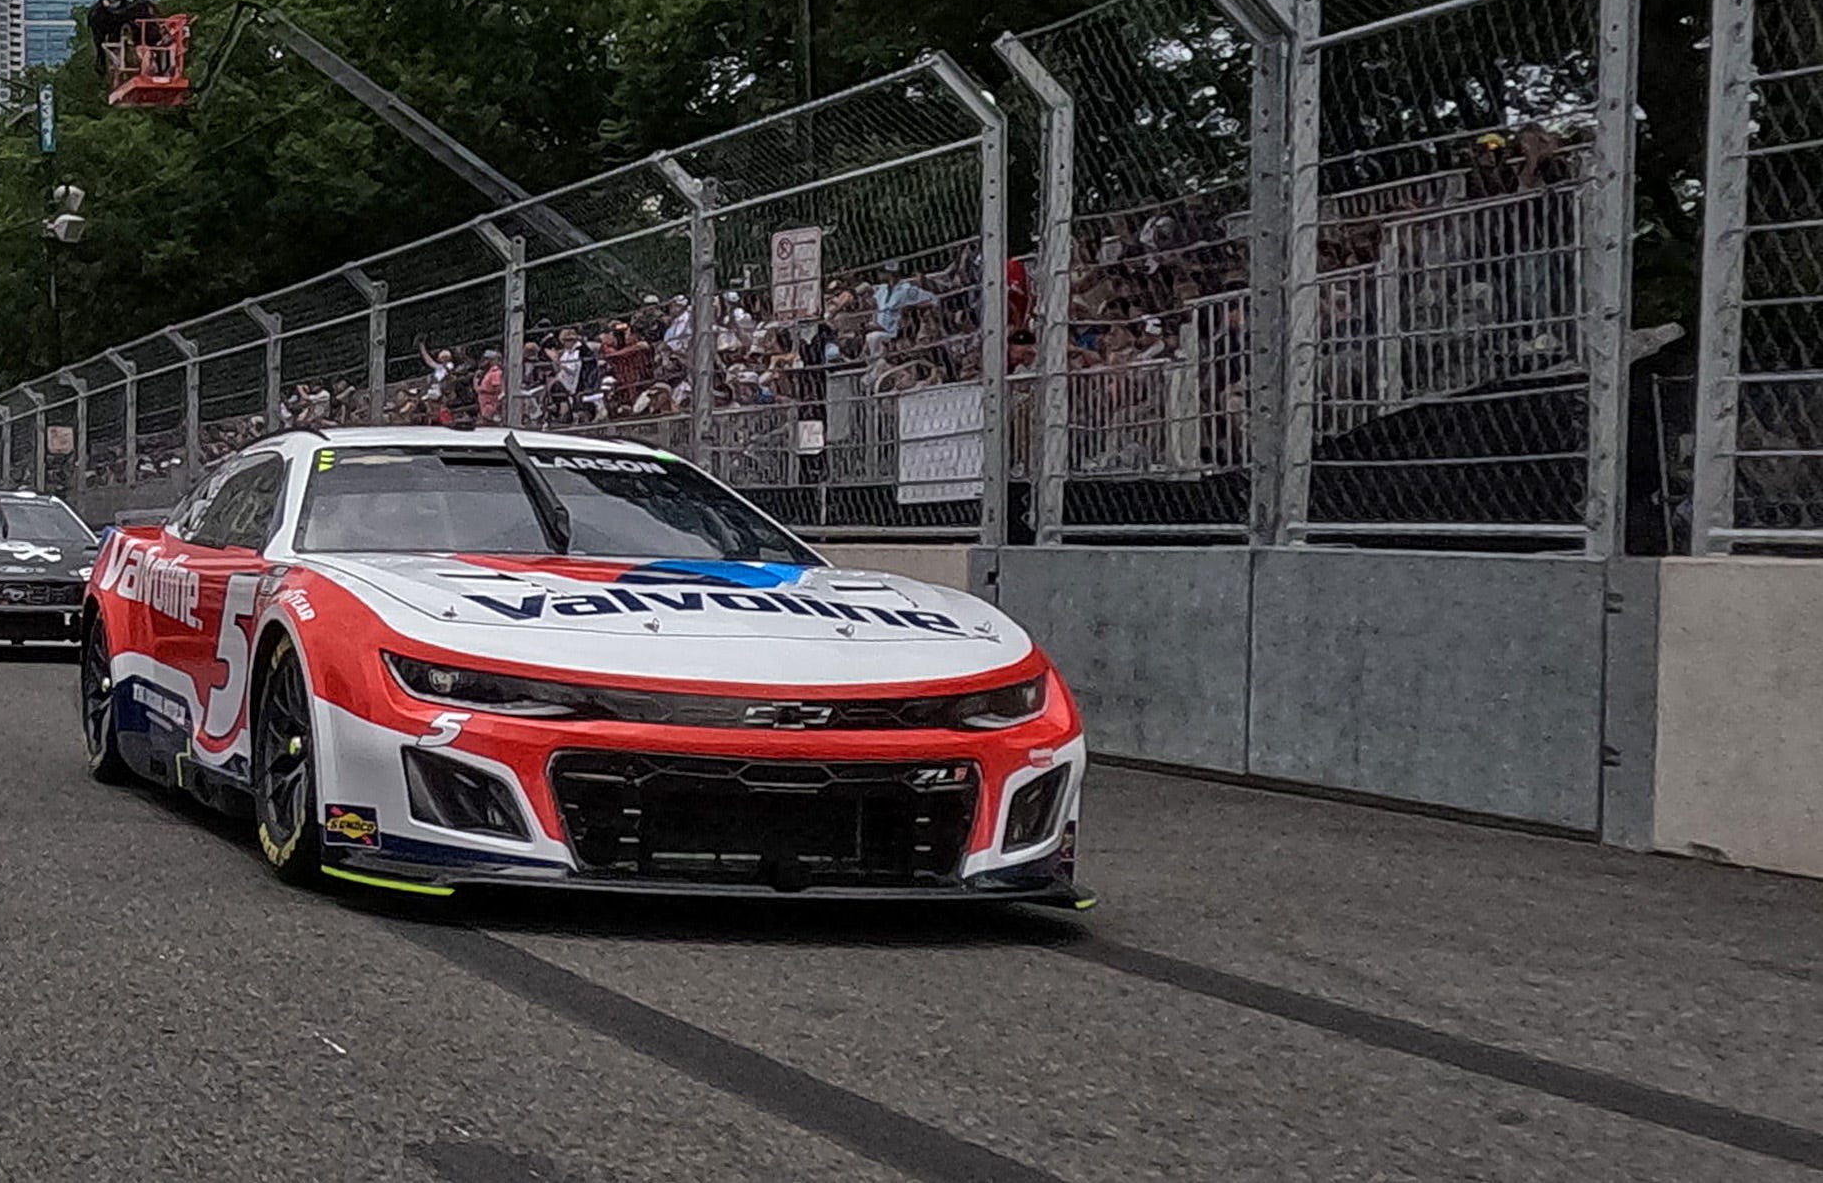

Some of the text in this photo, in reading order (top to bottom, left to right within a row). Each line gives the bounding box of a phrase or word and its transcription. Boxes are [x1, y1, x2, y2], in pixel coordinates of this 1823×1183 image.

[528, 455, 668, 475] LARSON
[463, 589, 967, 637] Valvoline
[203, 574, 263, 738] 5
[417, 713, 471, 746] 5
